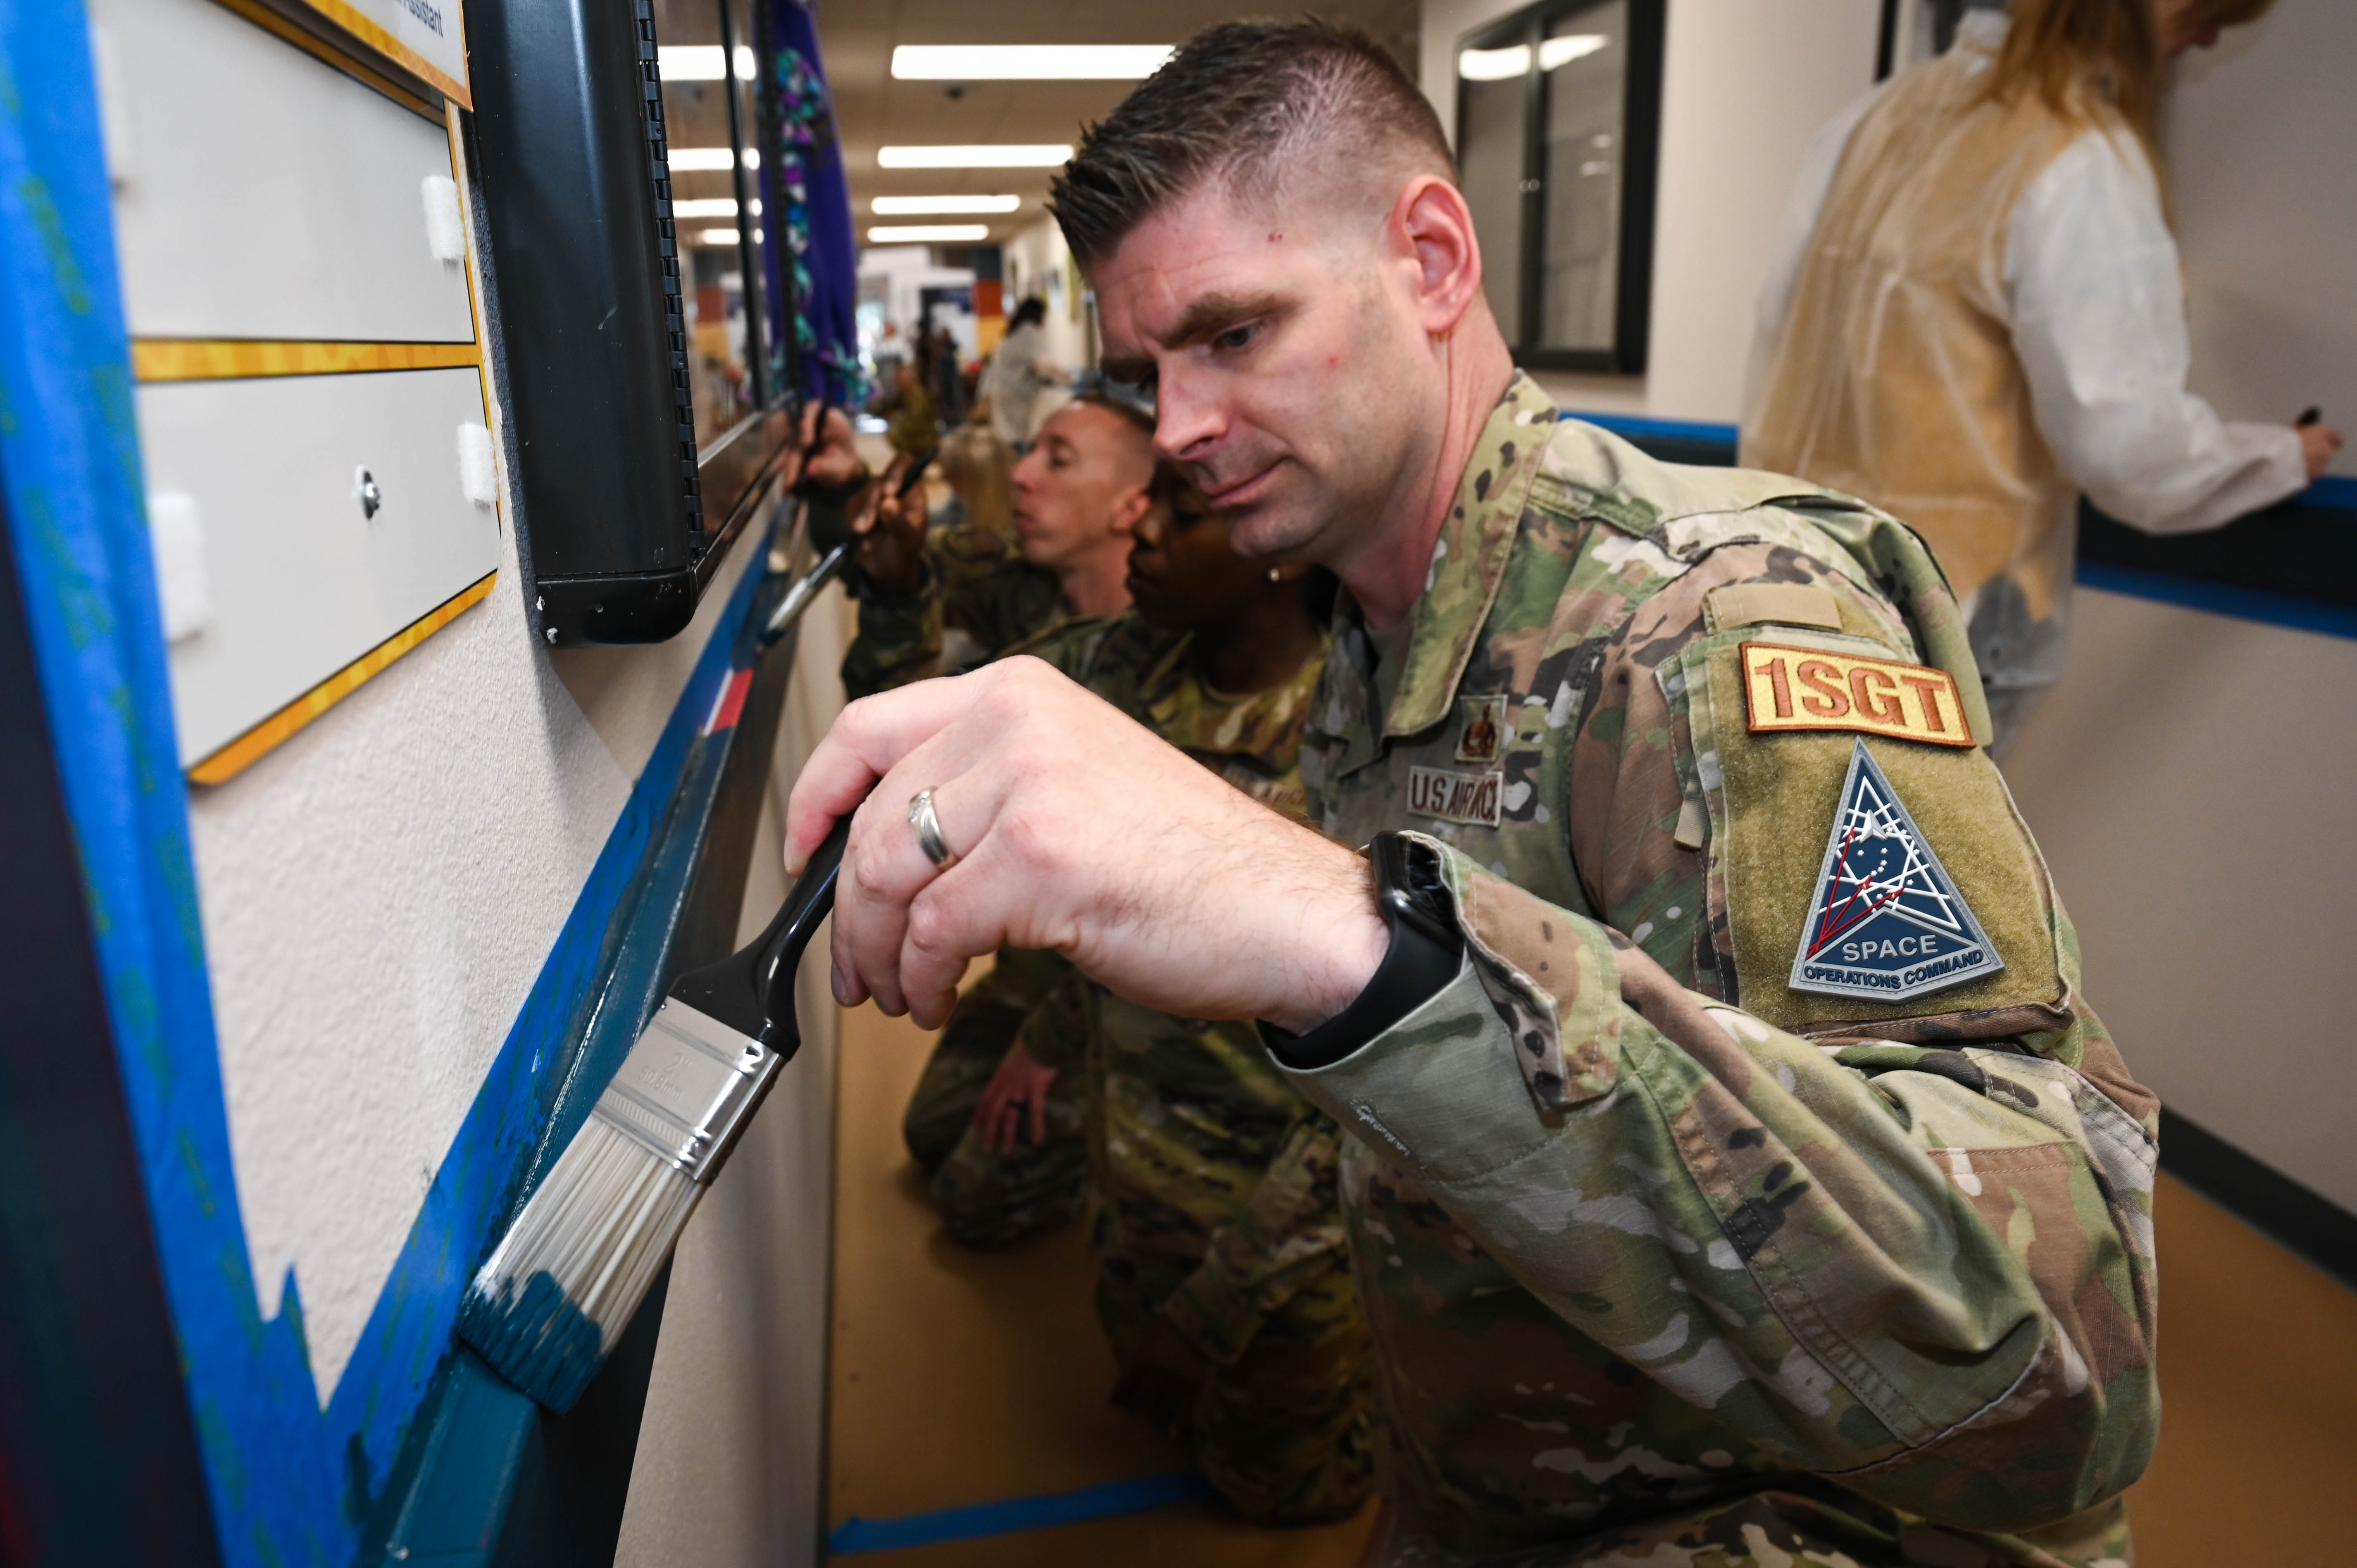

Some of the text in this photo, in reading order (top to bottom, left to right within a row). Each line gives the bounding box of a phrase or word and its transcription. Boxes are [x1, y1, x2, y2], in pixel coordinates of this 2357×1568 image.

[1755, 657, 1945, 731] 1SGT
[1843, 934, 1939, 962] SPACE
[1804, 949, 1984, 989] OPERATIONS COMMAND
